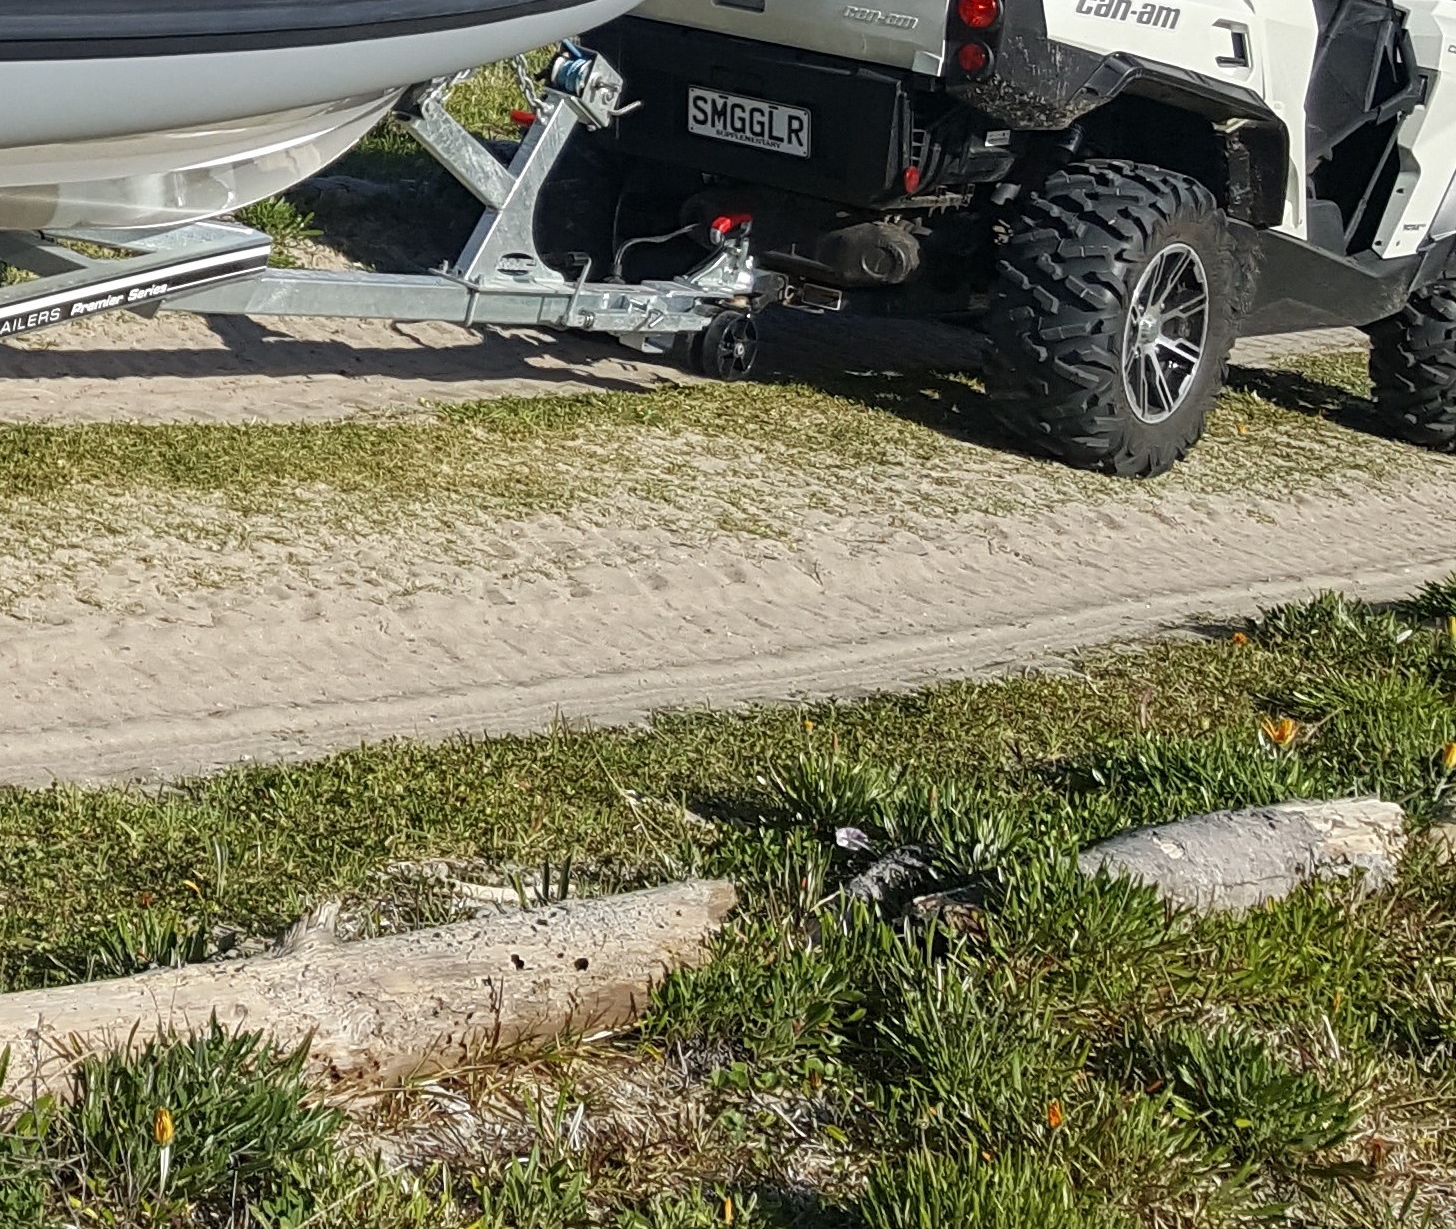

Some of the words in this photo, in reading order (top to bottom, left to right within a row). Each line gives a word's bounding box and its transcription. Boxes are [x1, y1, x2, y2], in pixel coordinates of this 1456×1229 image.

[692, 95, 804, 147] SMGGLR
[70, 294, 124, 317] Premier
[127, 283, 168, 302] Series
